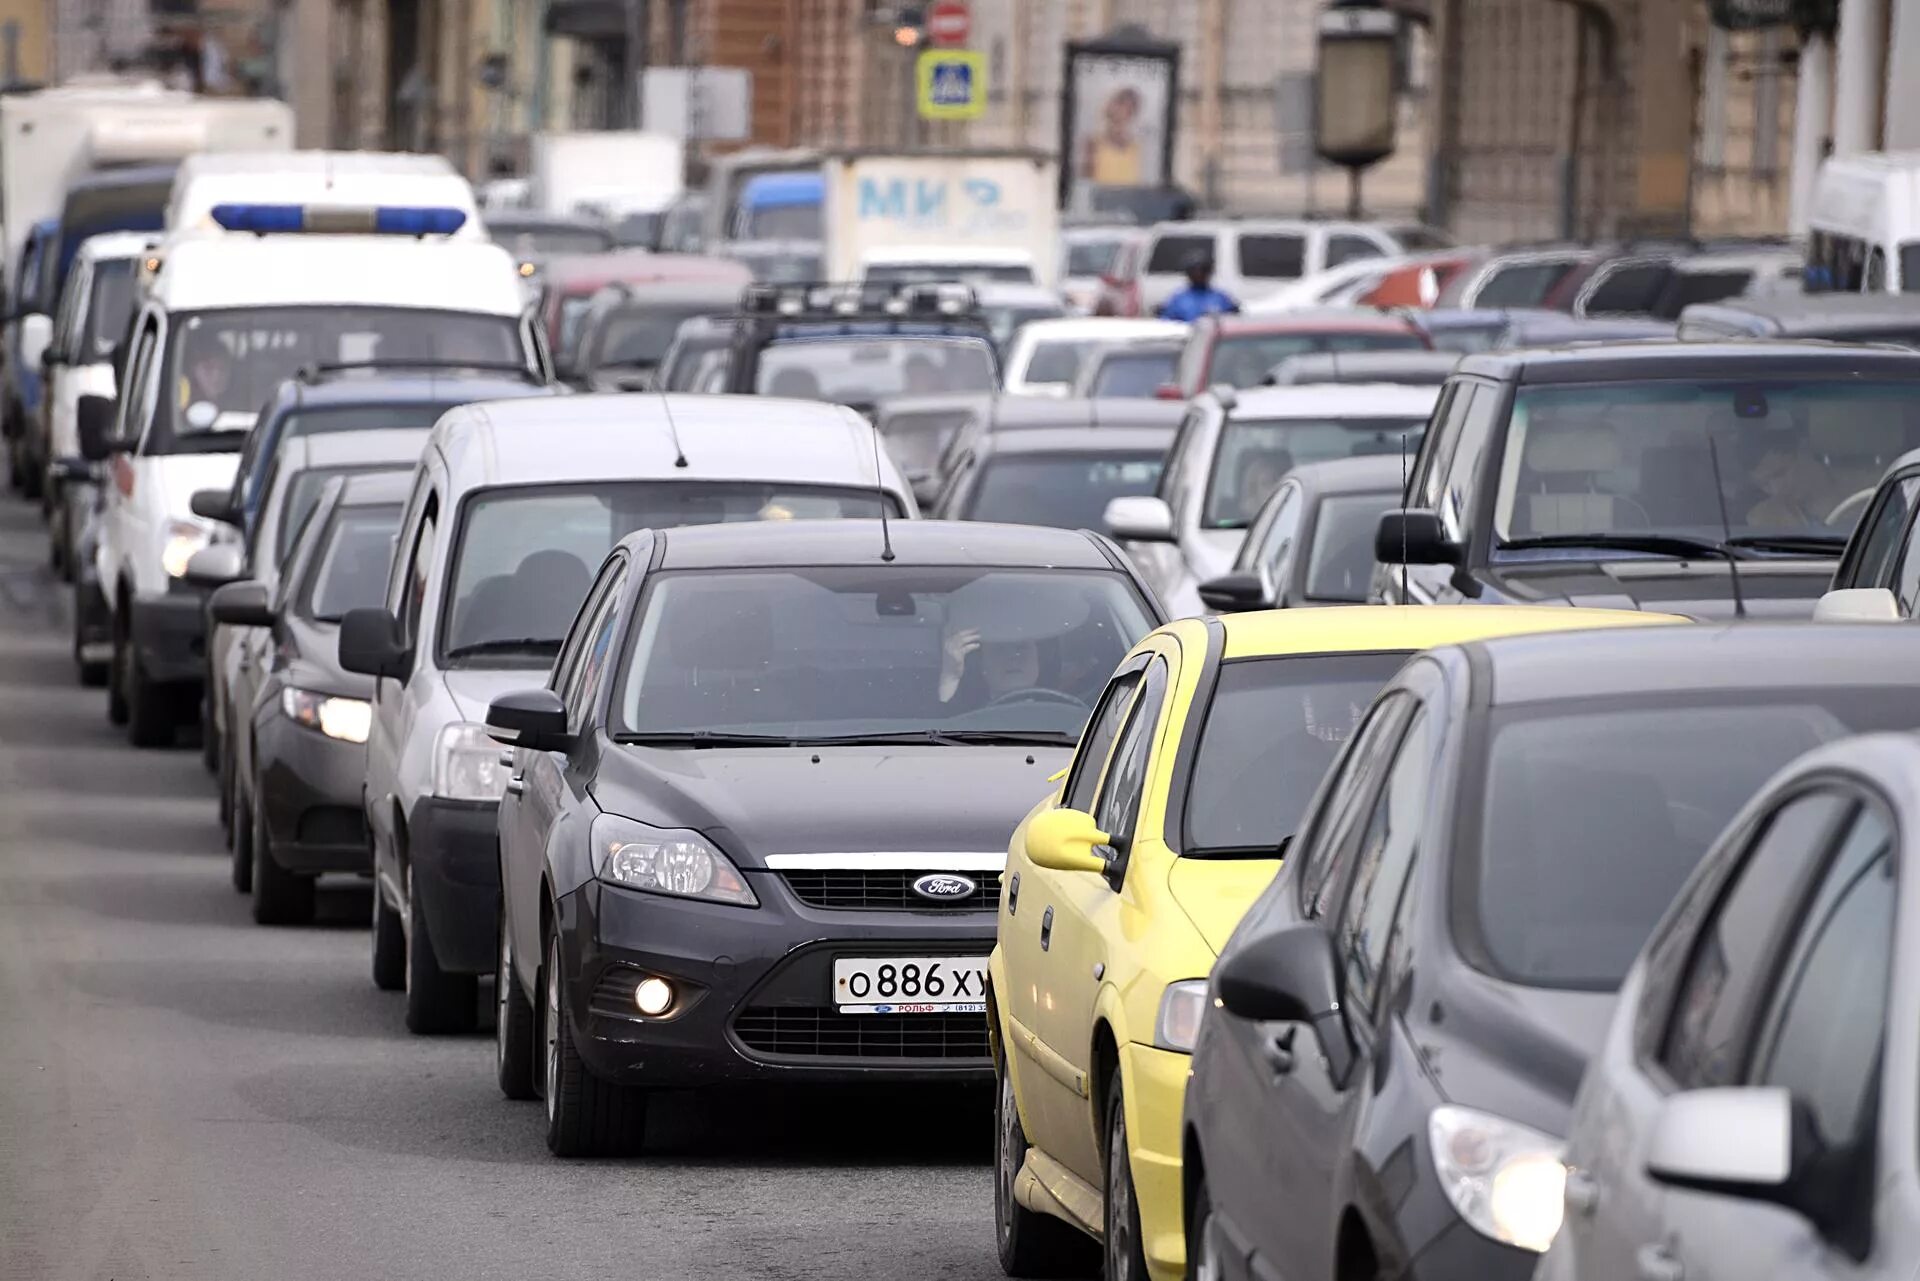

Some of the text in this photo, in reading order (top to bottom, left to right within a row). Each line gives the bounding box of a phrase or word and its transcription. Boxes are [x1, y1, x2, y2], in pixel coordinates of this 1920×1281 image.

[928, 879, 961, 894] Ford
[898, 1004, 934, 1013] РОЛЬФ
[955, 1004, 976, 1012] (812)
